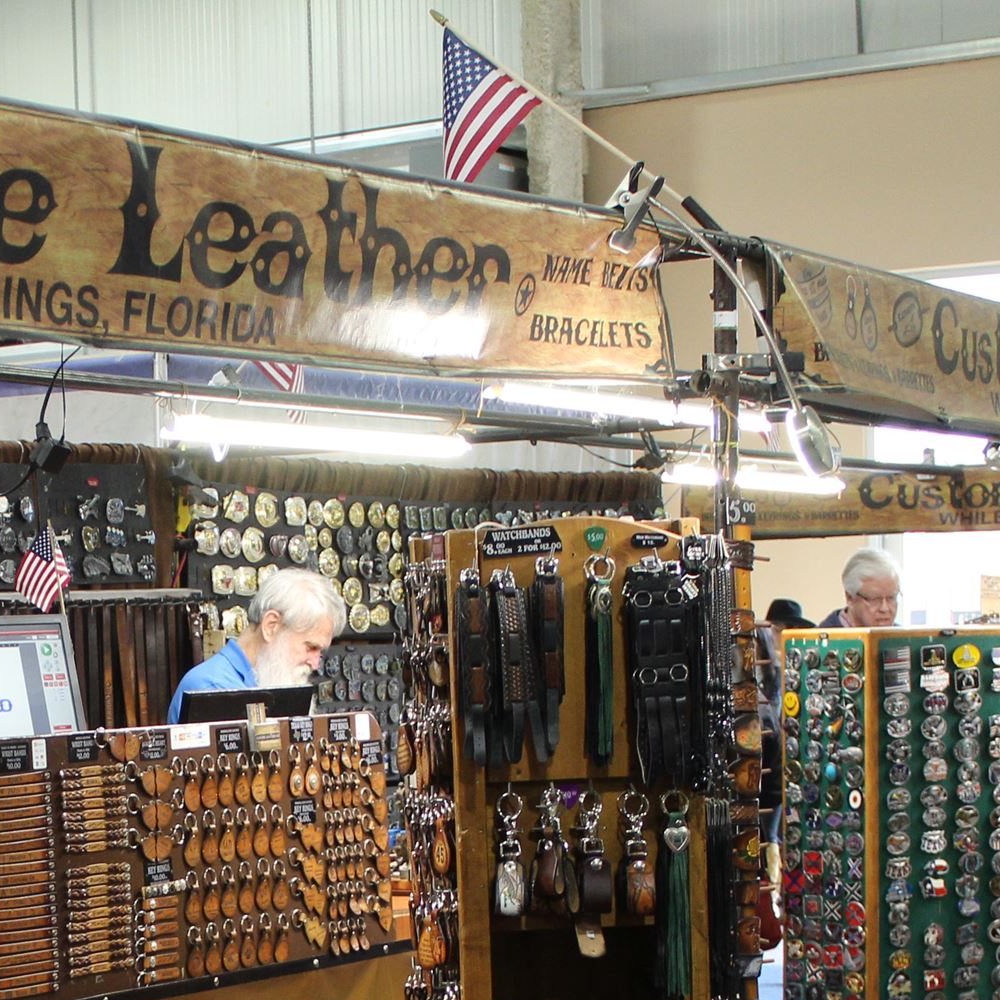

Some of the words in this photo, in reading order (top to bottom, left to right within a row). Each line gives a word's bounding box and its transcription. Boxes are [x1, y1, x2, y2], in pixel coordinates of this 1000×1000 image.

[107, 140, 511, 314] Leather
[542, 254, 593, 285] NAME
[601, 258, 650, 293] BELTS
[123, 292, 278, 346] FLORIDA
[529, 314, 652, 349] BRACELETS
[491, 528, 551, 541] WATCHBANDS
[524, 544, 538, 552] FOR
[437, 847, 445, 865] 45
